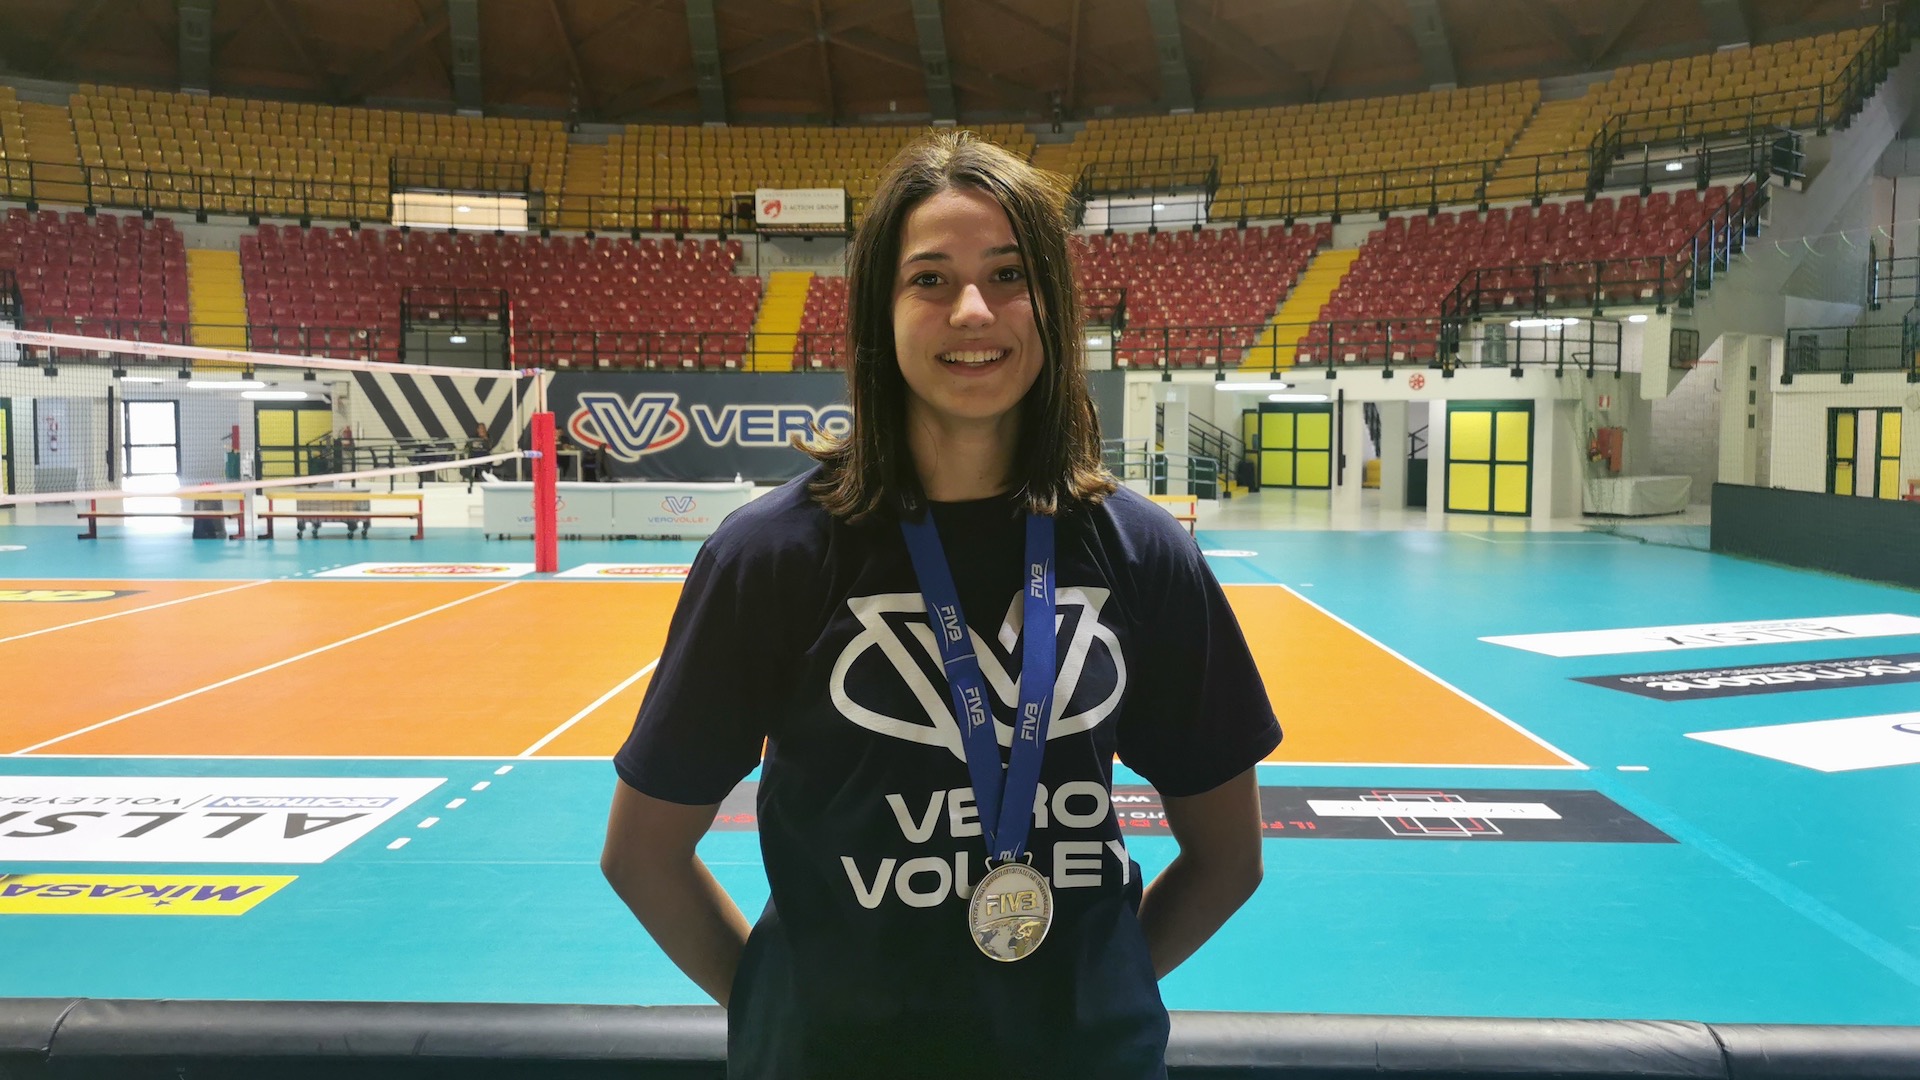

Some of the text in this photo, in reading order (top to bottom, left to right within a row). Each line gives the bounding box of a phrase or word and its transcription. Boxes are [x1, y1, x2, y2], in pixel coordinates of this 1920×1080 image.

[690, 405, 856, 447] VERO
[1030, 562, 1043, 599] FIVB
[941, 604, 963, 642] FIVB
[965, 686, 986, 727] FIVB
[1020, 702, 1039, 741] FIVB
[1130, 811, 1166, 819] UTO
[840, 839, 1131, 910] VOLEY
[1, 883, 266, 907] MIKASA
[985, 889, 1039, 917] FIVB
